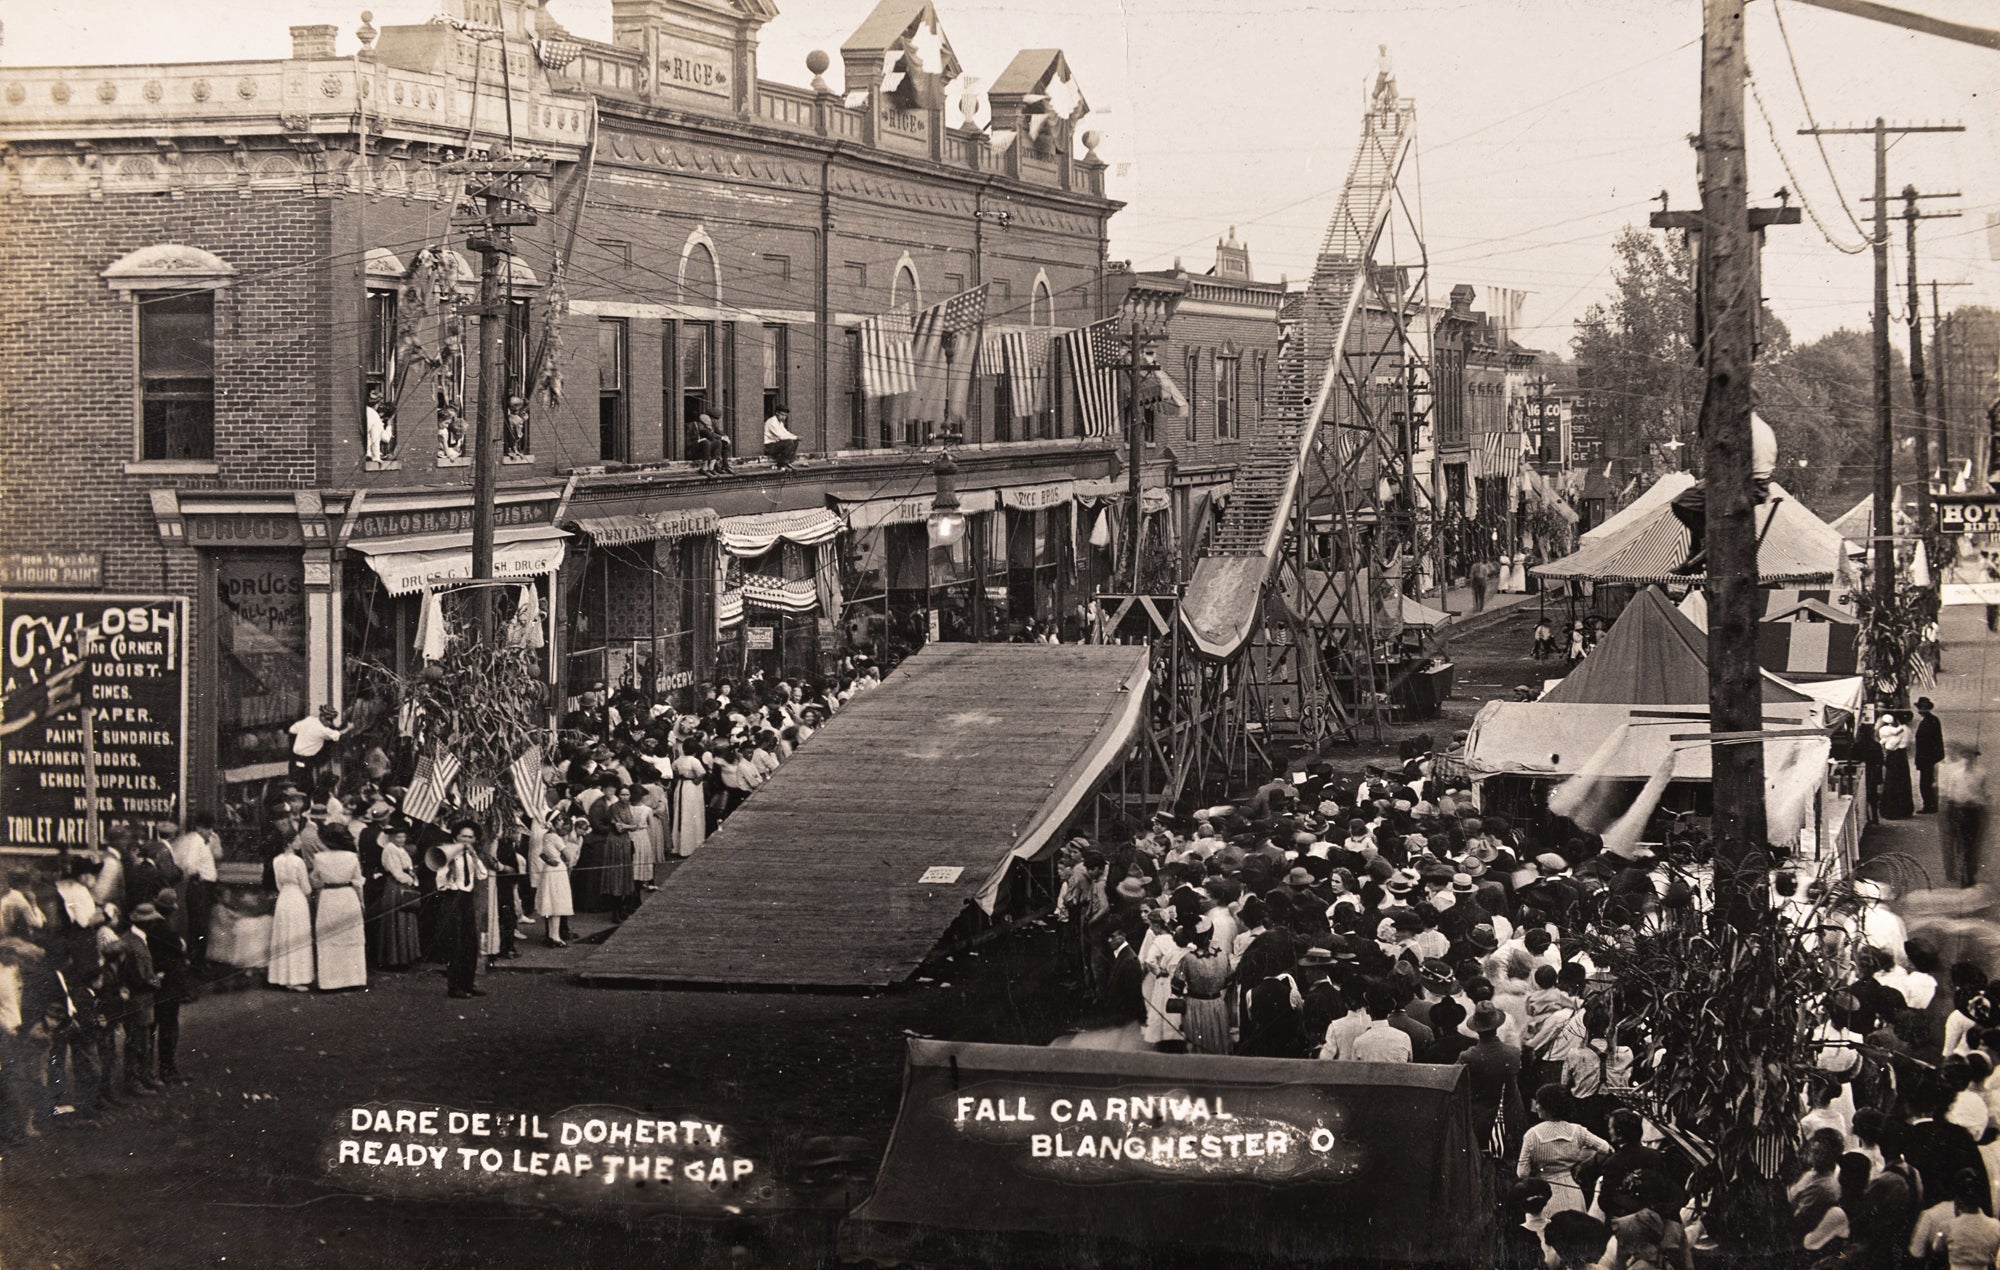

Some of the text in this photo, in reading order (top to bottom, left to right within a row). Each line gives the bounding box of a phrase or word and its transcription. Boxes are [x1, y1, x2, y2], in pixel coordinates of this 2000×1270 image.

[673, 57, 713, 86] RICE
[889, 109, 918, 133] RICE
[1018, 491, 1036, 506] RICE
[449, 505, 534, 529] DRGIST.
[901, 502, 923, 519] RICE
[196, 520, 289, 540] DRUGS
[663, 513, 717, 534] GROCERY
[16, 567, 58, 582] LIQUID
[63, 567, 100, 582] PAINT
[494, 561, 511, 574] SH,
[515, 559, 547, 572] DRUGS
[229, 572, 303, 595] DRUGS
[110, 633, 164, 662] CORNER
[92, 662, 162, 678] UGGIST.
[92, 684, 132, 700] CINES.
[90, 707, 153, 723] PAPER.
[103, 731, 174, 746] SUNDRIES.
[8, 750, 141, 767] STATIONERY BOOKS.
[40, 772, 161, 790] SCHOOL SUPPLIES.
[7, 815, 53, 843] TOILET
